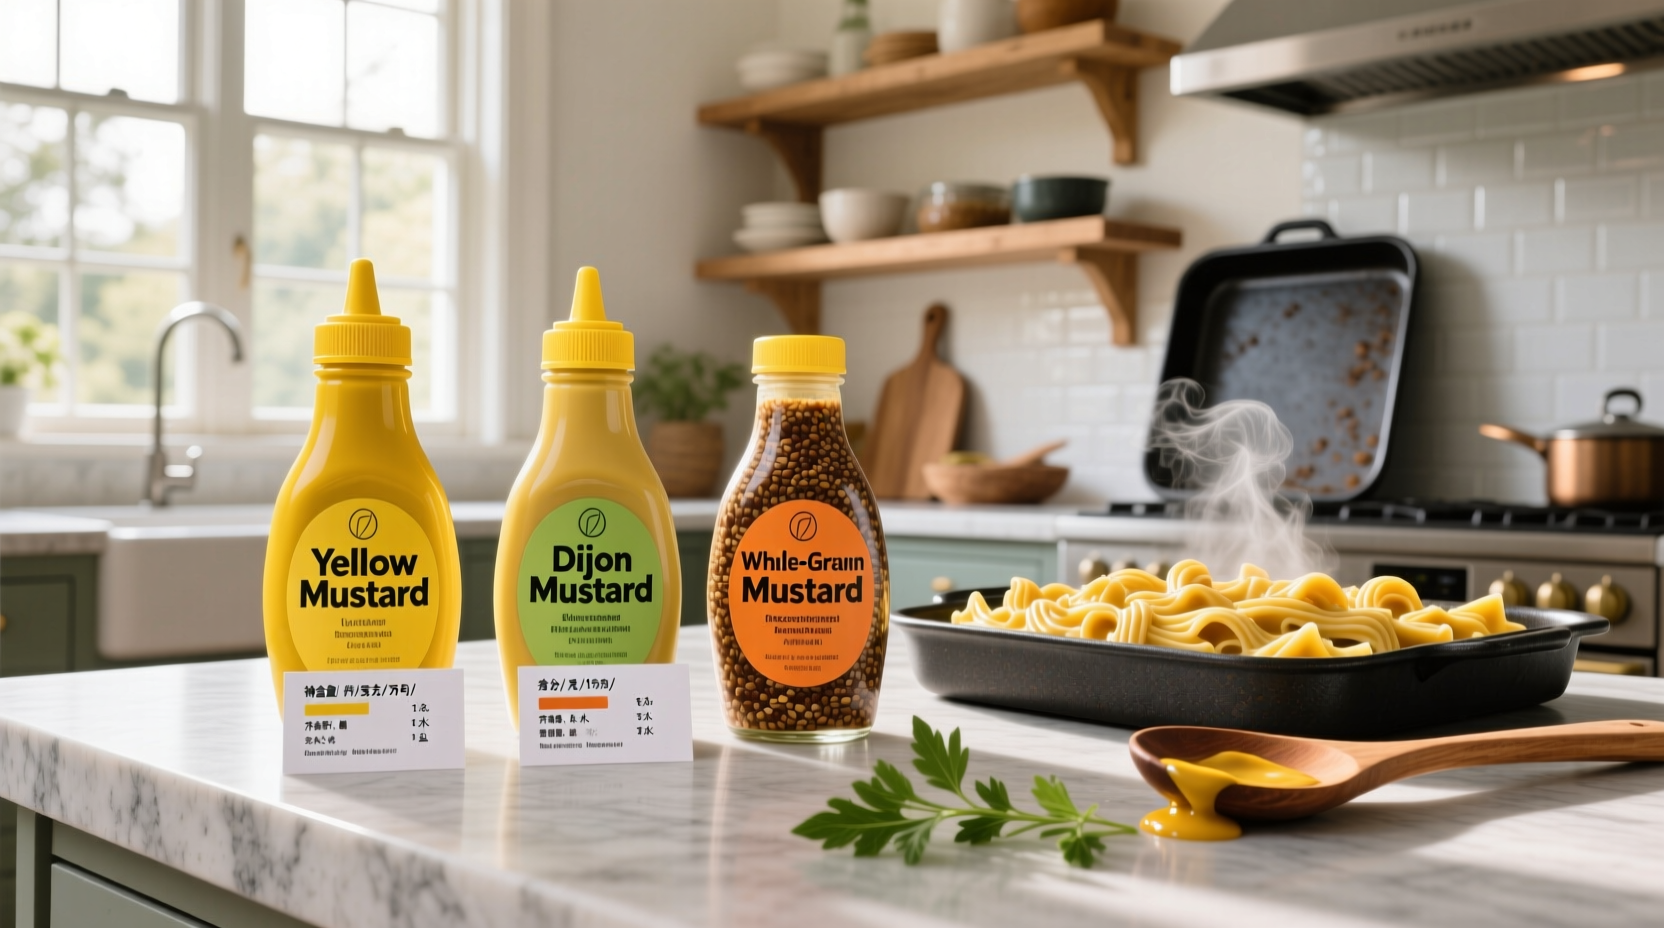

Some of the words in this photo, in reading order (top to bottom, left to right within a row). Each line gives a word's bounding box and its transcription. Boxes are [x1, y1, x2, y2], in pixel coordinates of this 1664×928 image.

[311, 547, 418, 577] Yellow
[553, 544, 632, 581] Dijon
[300, 577, 429, 608] Mustard
[530, 574, 653, 604] Mustard
[742, 575, 863, 604] Mustard
